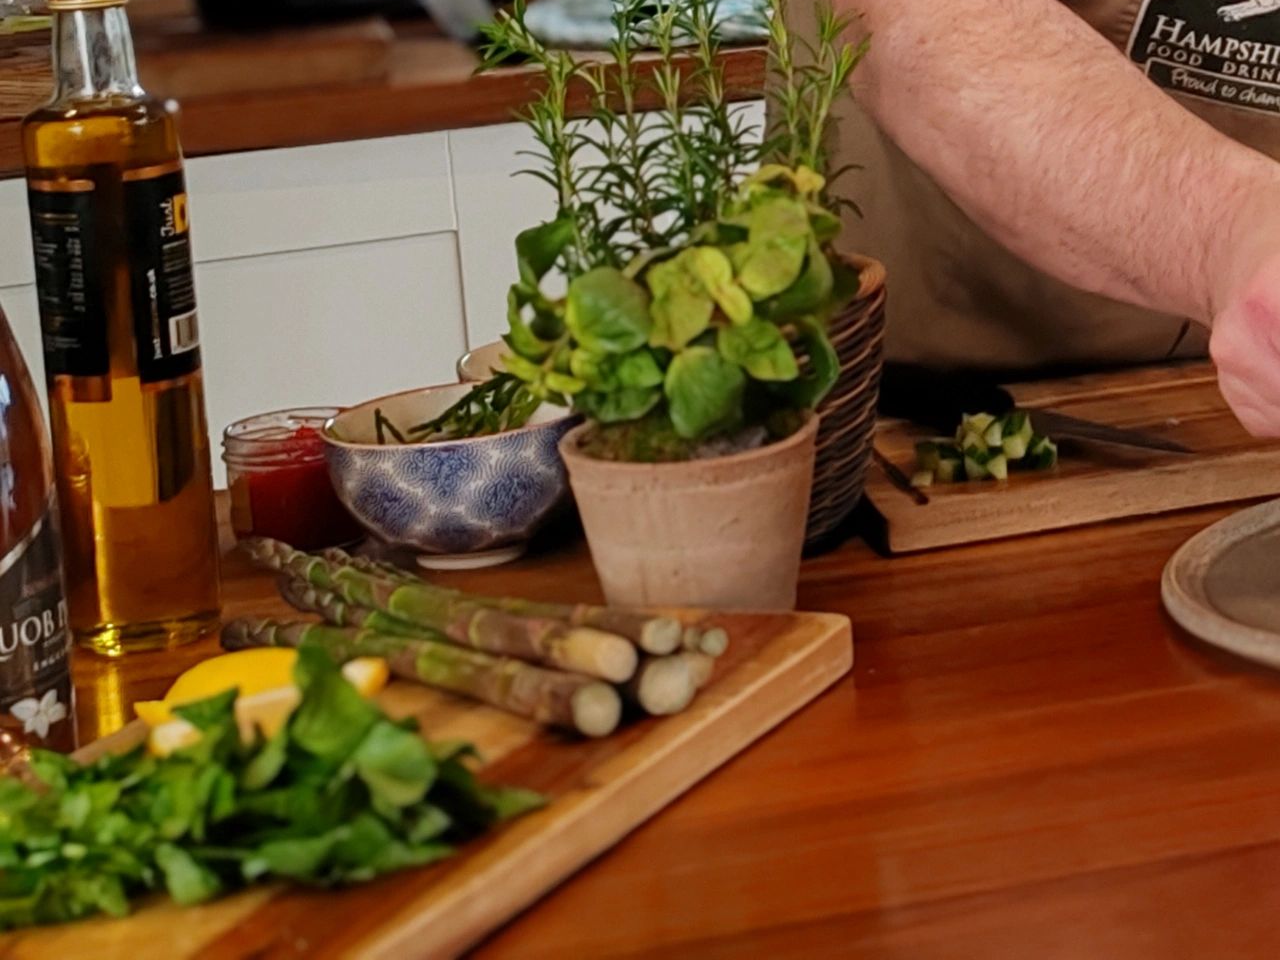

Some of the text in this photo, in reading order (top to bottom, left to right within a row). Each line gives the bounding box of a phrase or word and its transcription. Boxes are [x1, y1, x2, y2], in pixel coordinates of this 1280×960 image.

[1146, 41, 1203, 67] FOOD
[1171, 67, 1217, 95] Proud
[1221, 83, 1236, 97] to
[0, 609, 55, 662] UOB
